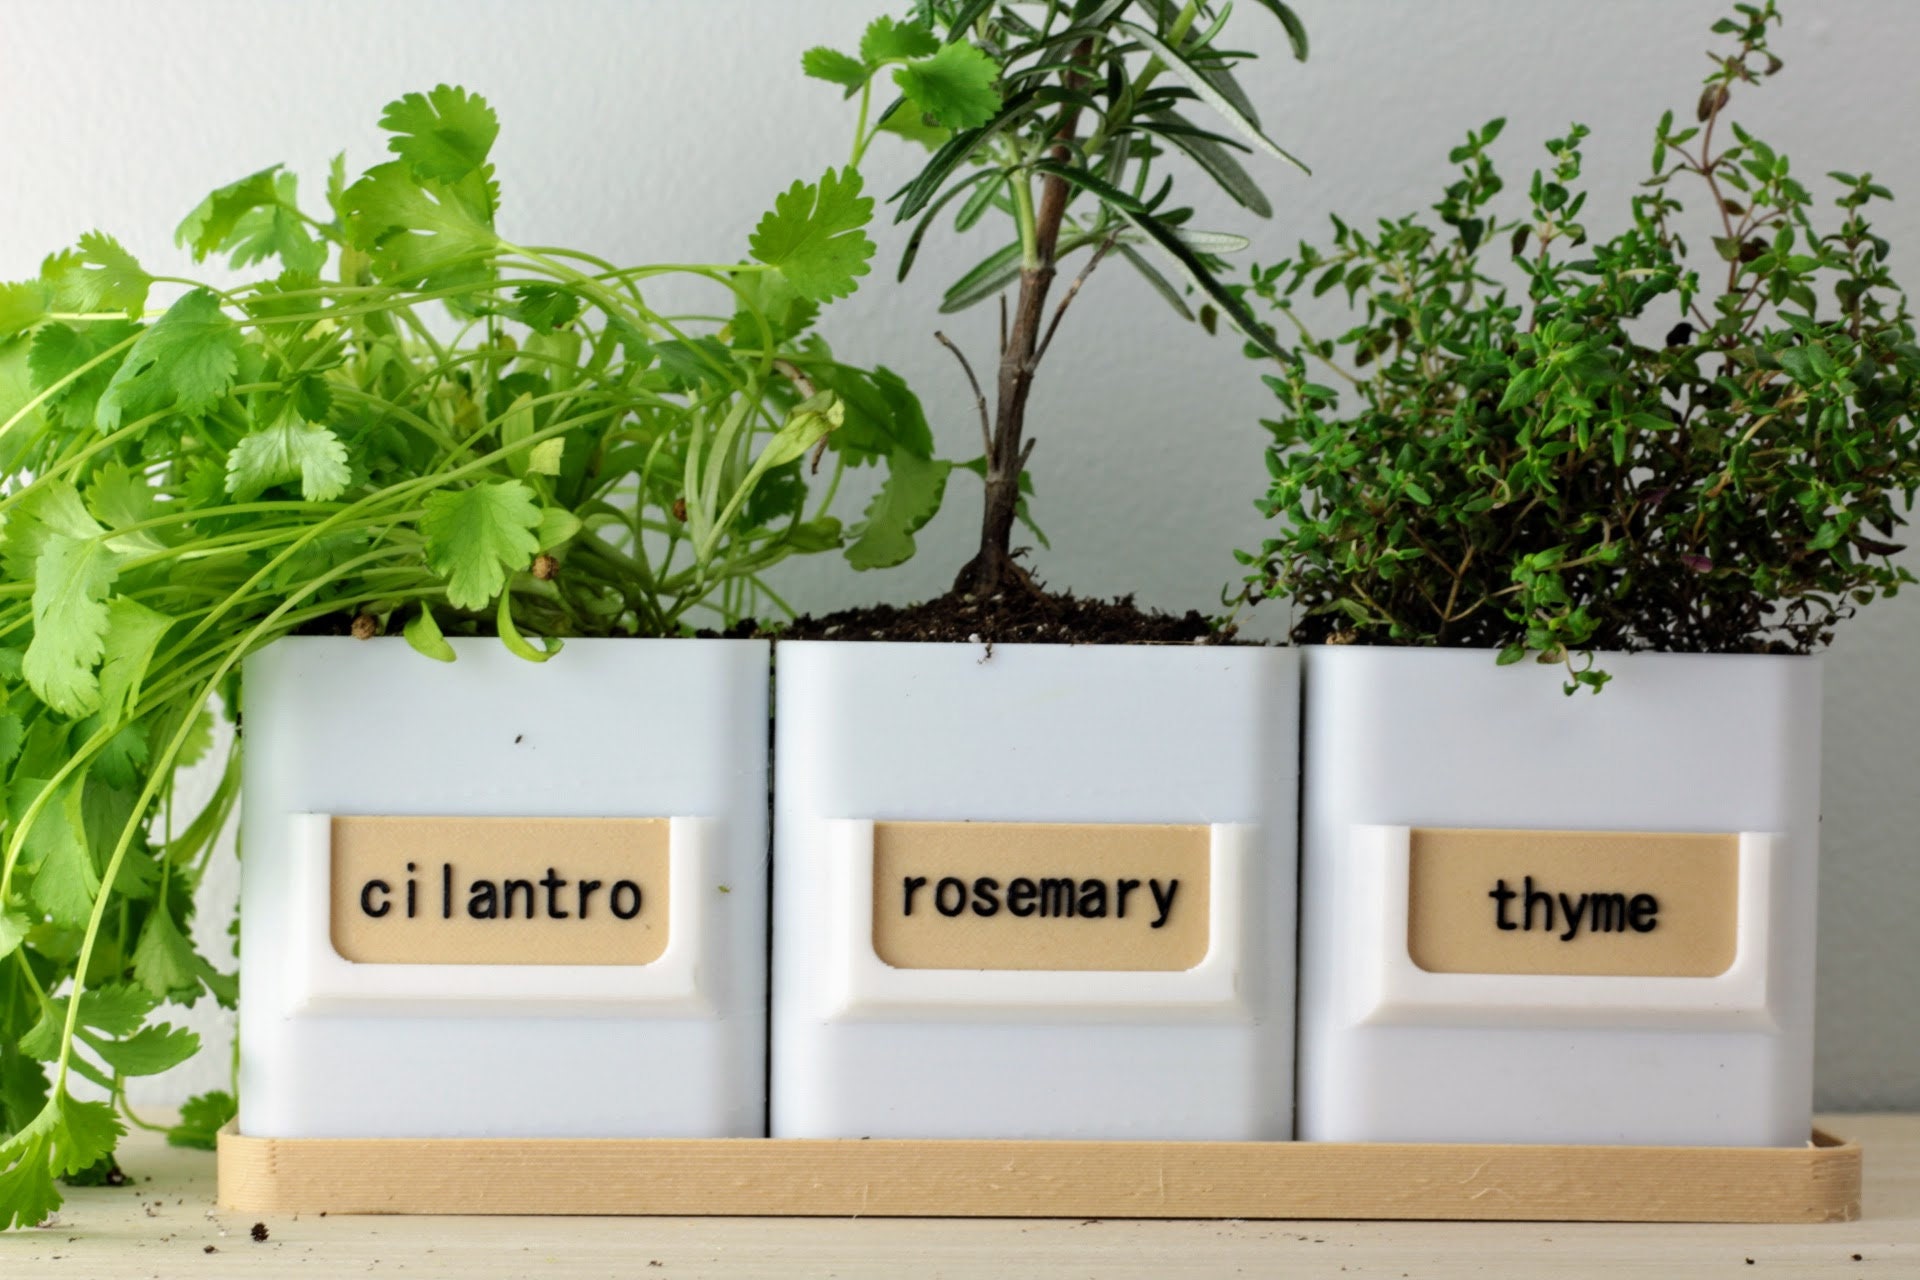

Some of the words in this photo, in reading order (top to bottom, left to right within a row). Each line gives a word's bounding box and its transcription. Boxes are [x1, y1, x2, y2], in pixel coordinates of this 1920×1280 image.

[360, 862, 644, 921] cilantro
[902, 875, 1181, 929] rosemary
[1488, 875, 1662, 942] thyme
